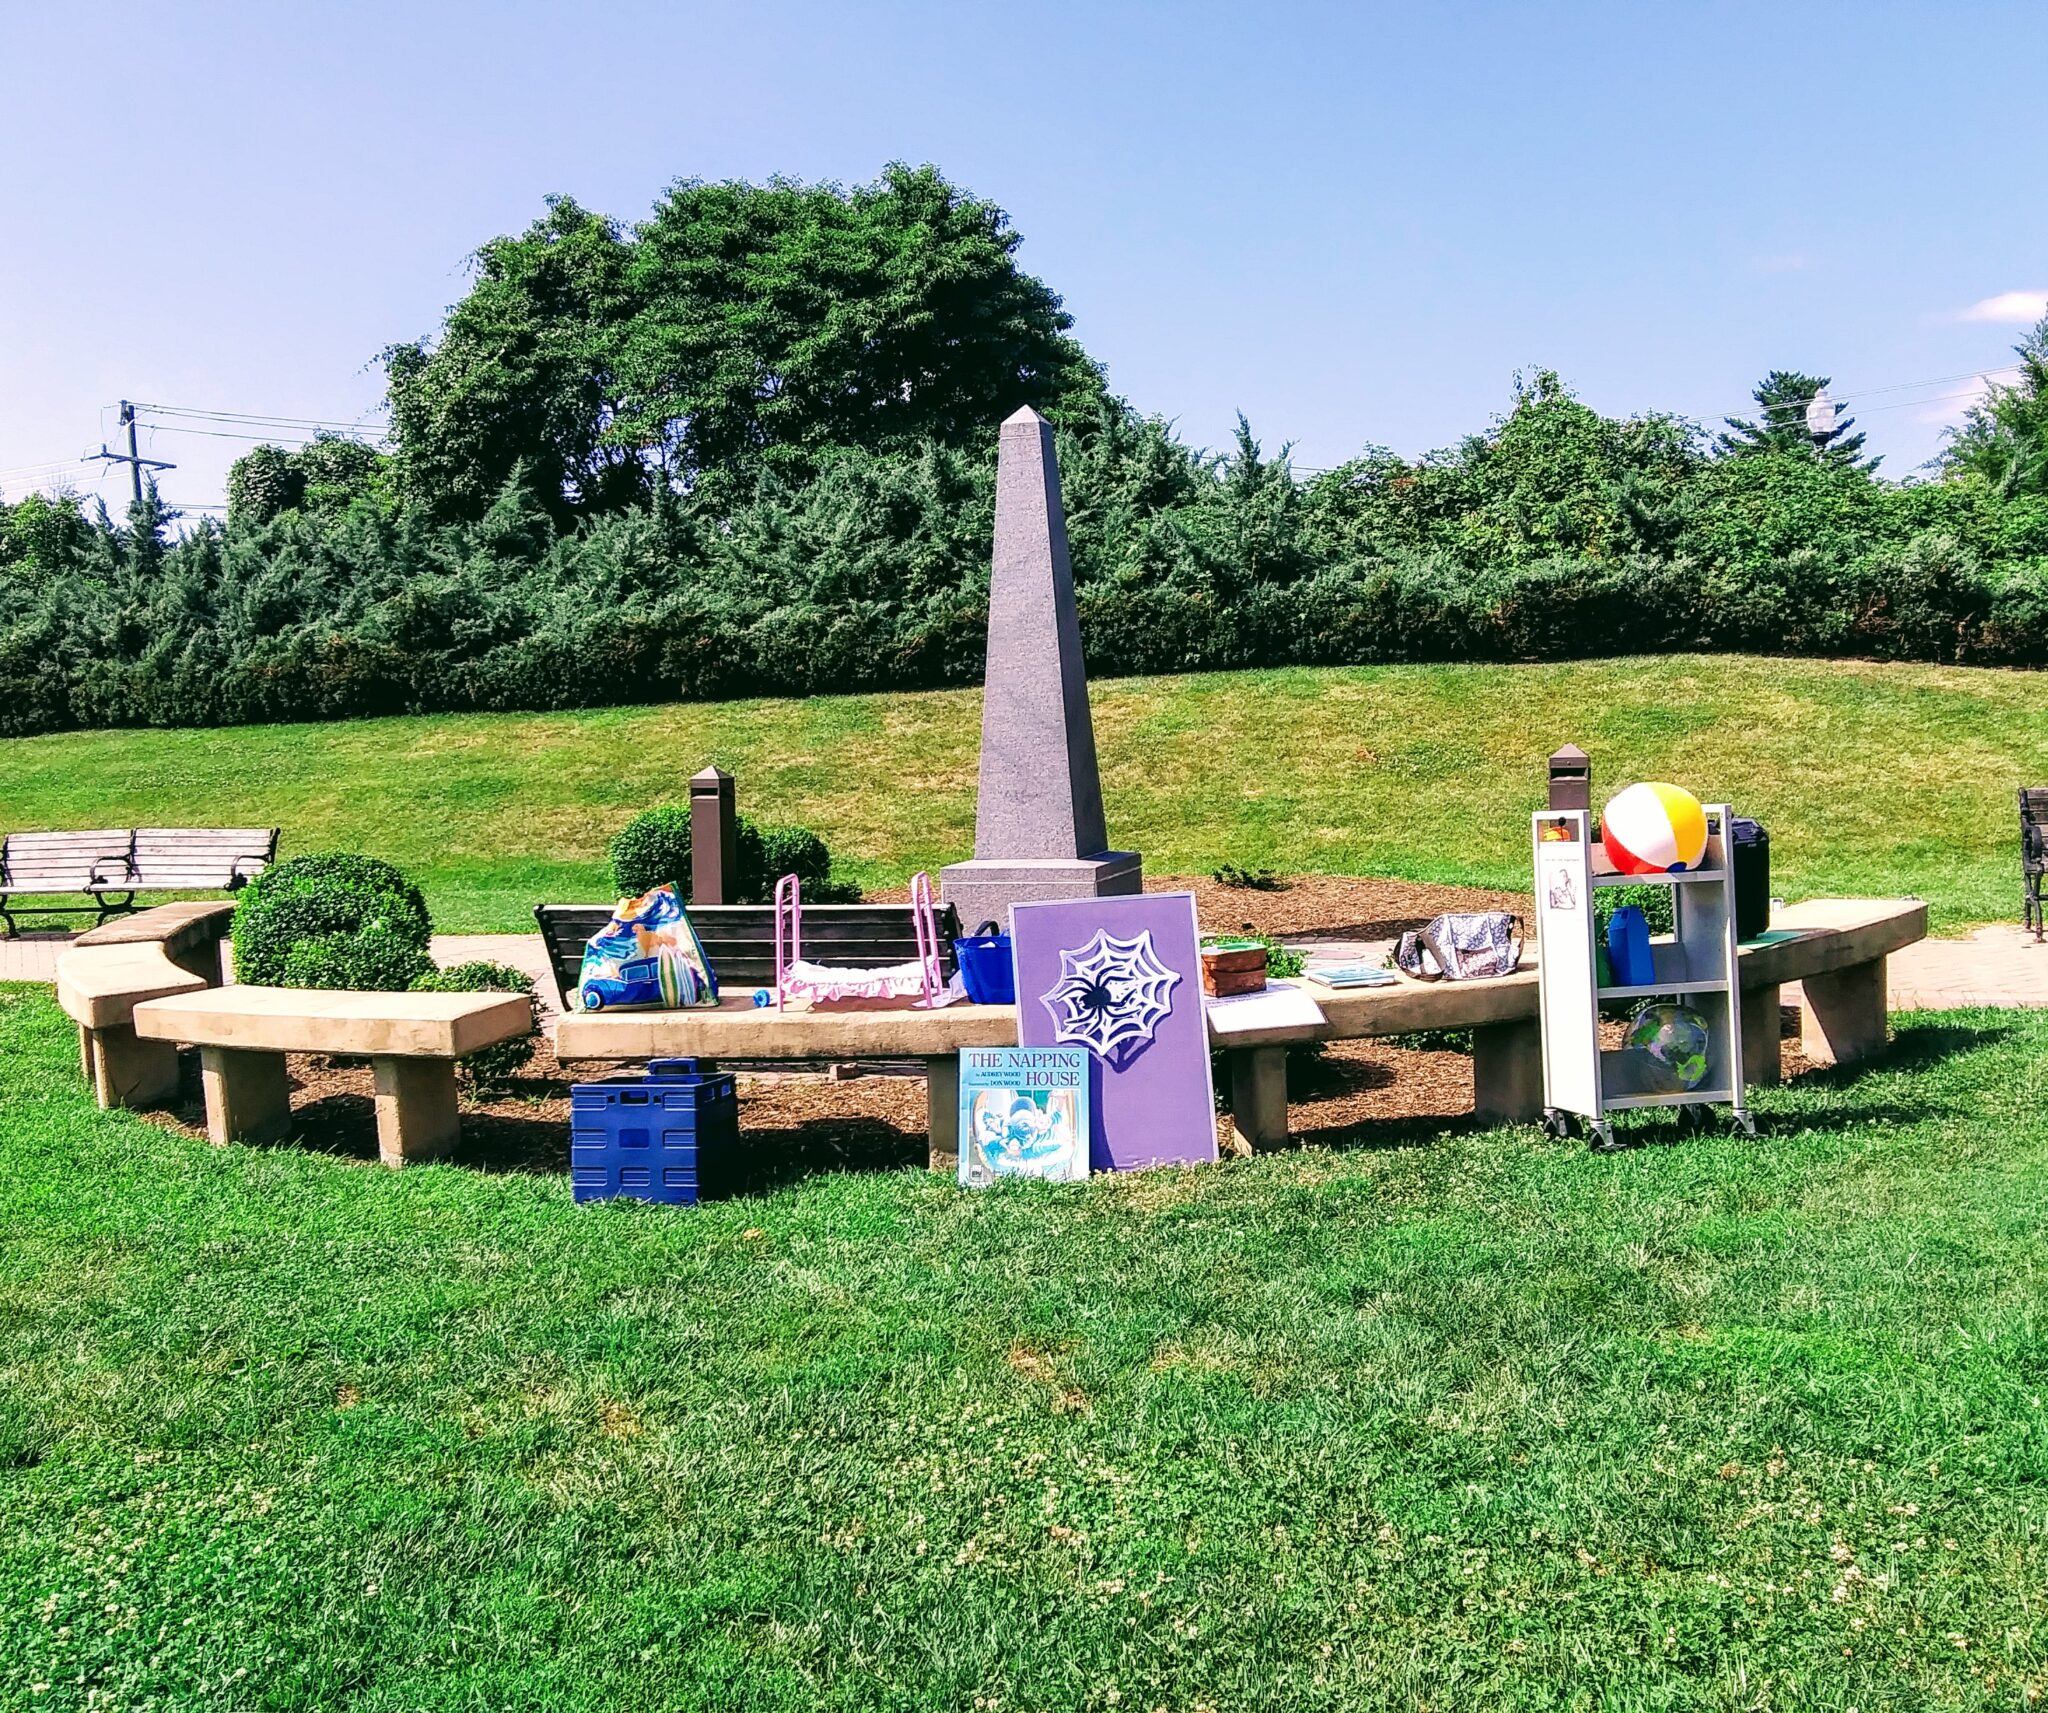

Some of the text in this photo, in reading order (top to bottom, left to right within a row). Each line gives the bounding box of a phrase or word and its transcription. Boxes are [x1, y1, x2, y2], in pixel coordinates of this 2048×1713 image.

[968, 1053, 1080, 1068] THE NAPPING
[1025, 1071, 1080, 1086] HOUSE
